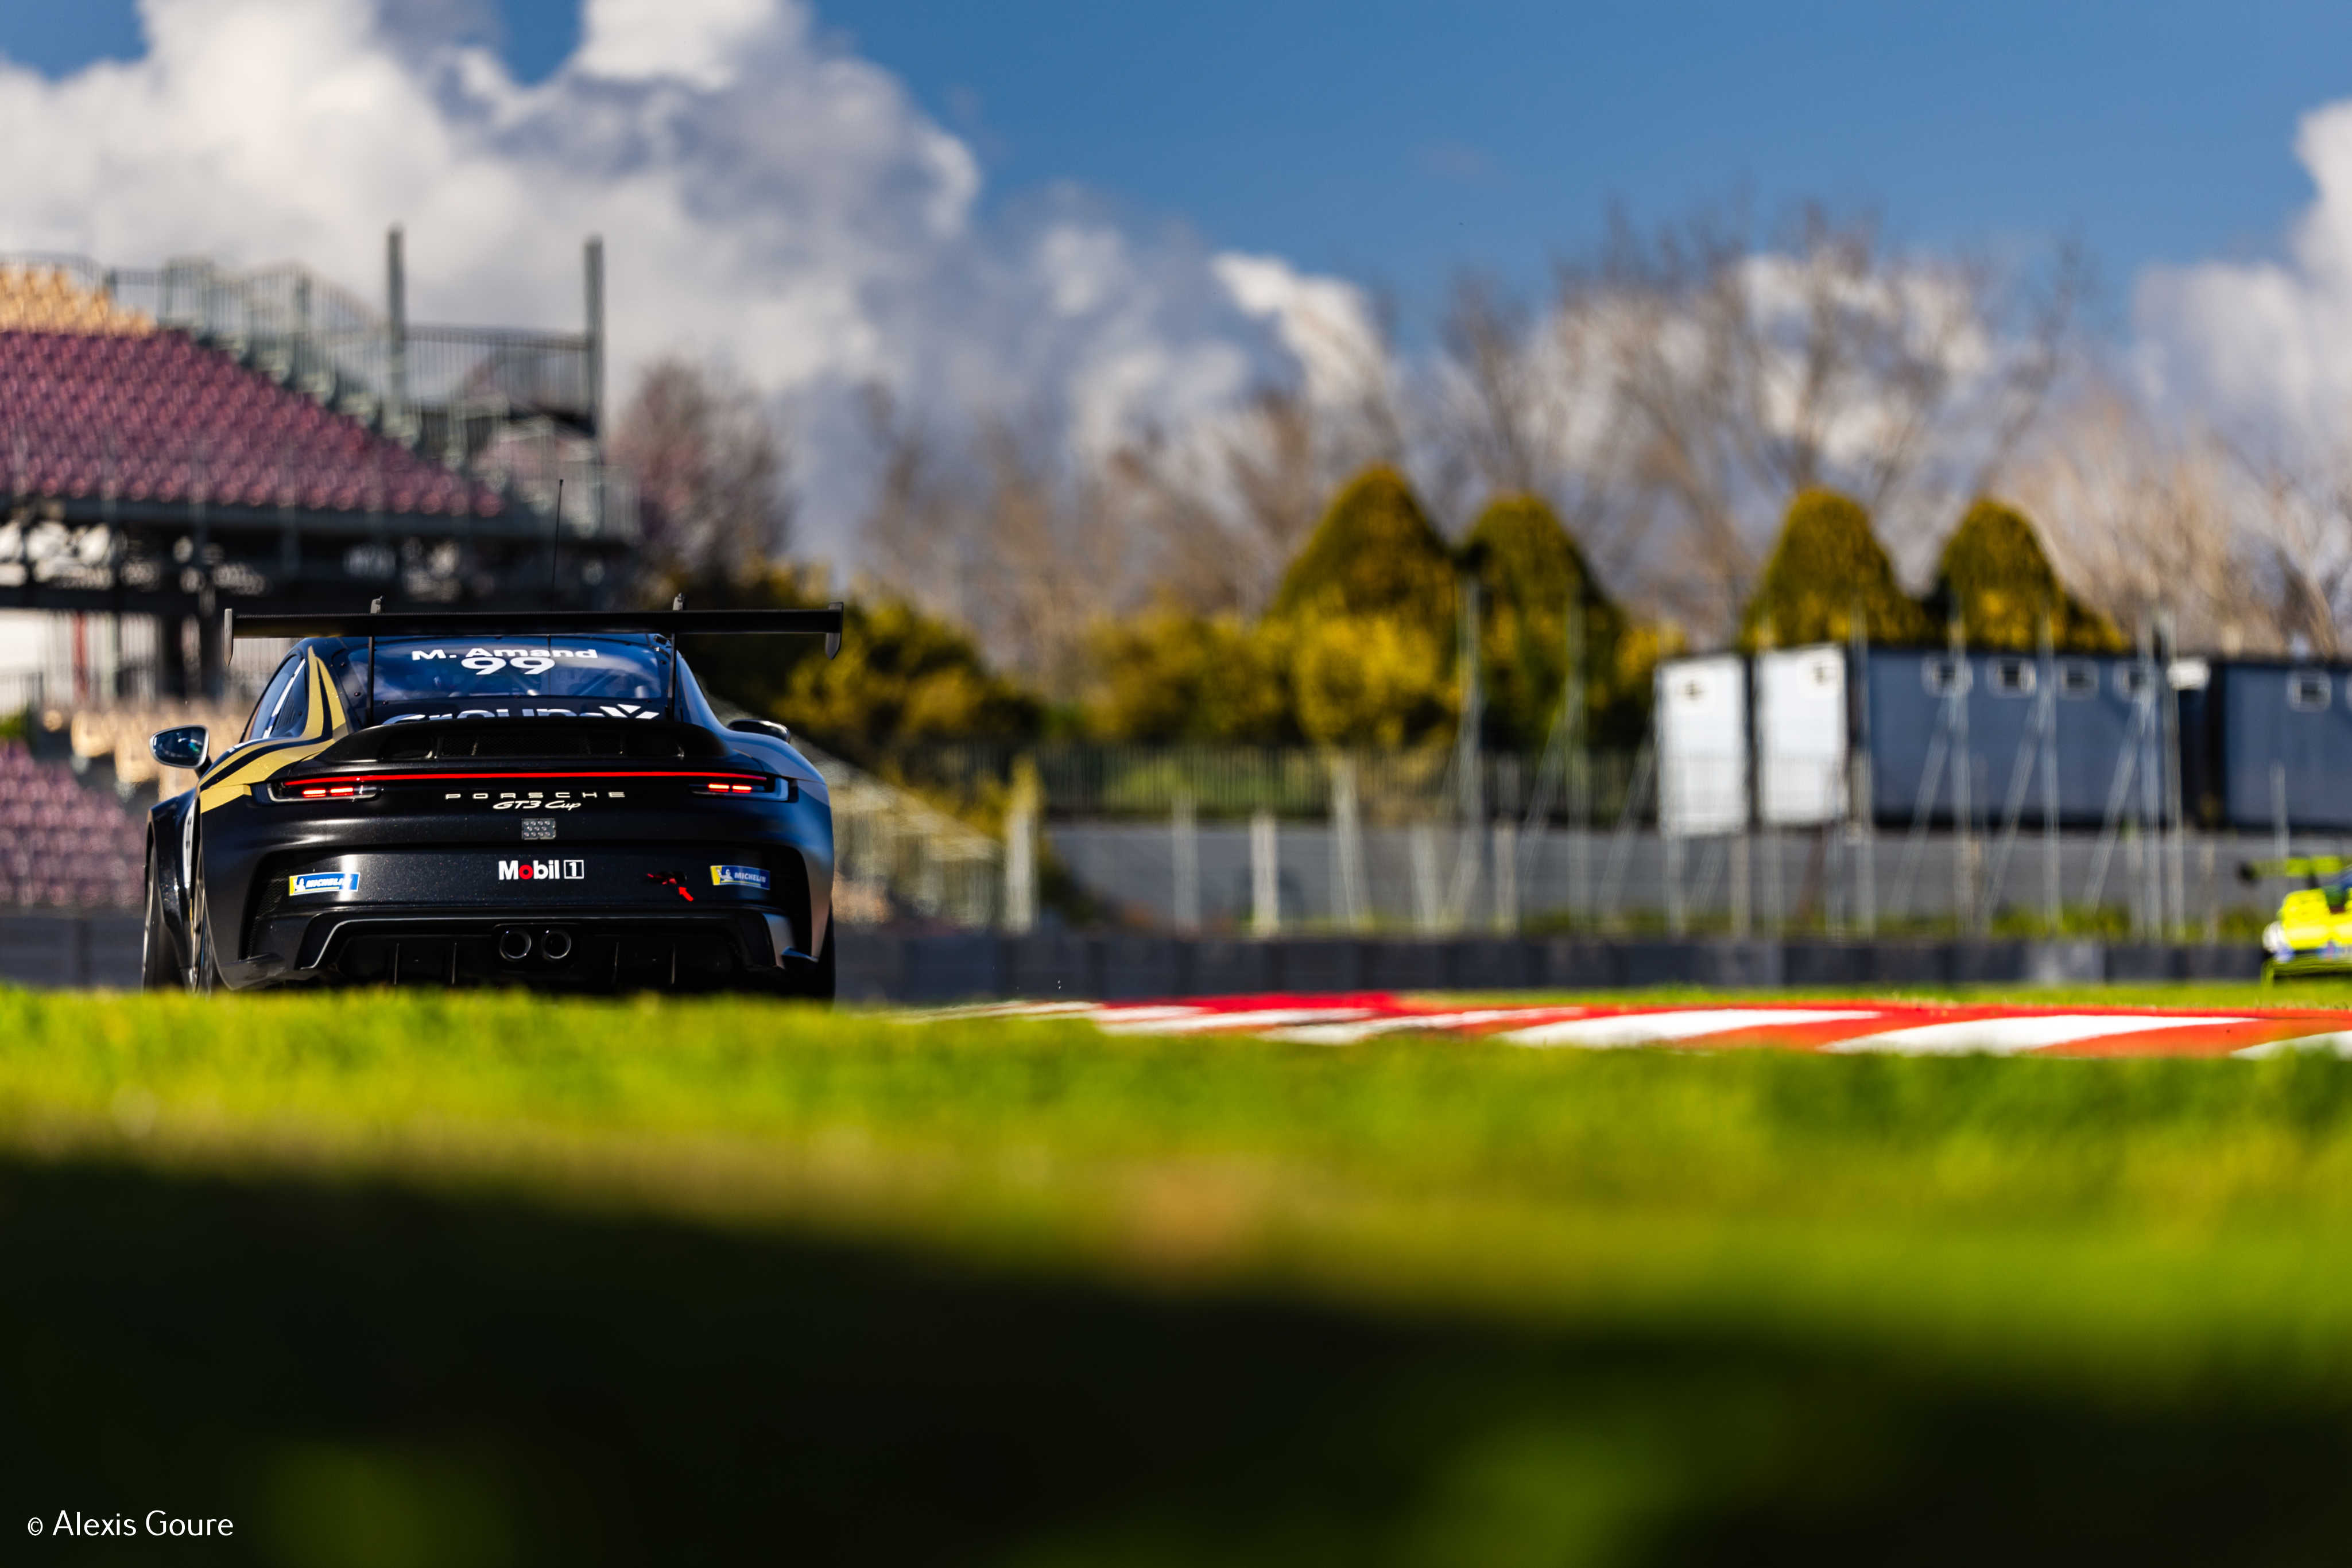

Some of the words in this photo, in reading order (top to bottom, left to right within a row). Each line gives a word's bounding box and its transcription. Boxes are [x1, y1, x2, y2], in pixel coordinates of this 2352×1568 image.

[412, 649, 457, 660] M.
[466, 647, 598, 658] Amand
[461, 657, 555, 675] 99
[445, 791, 625, 799] PORSCHE
[493, 800, 542, 810] GT3
[544, 800, 582, 811] Cup
[498, 859, 560, 880] Mobil
[734, 872, 766, 883] MICHELIN
